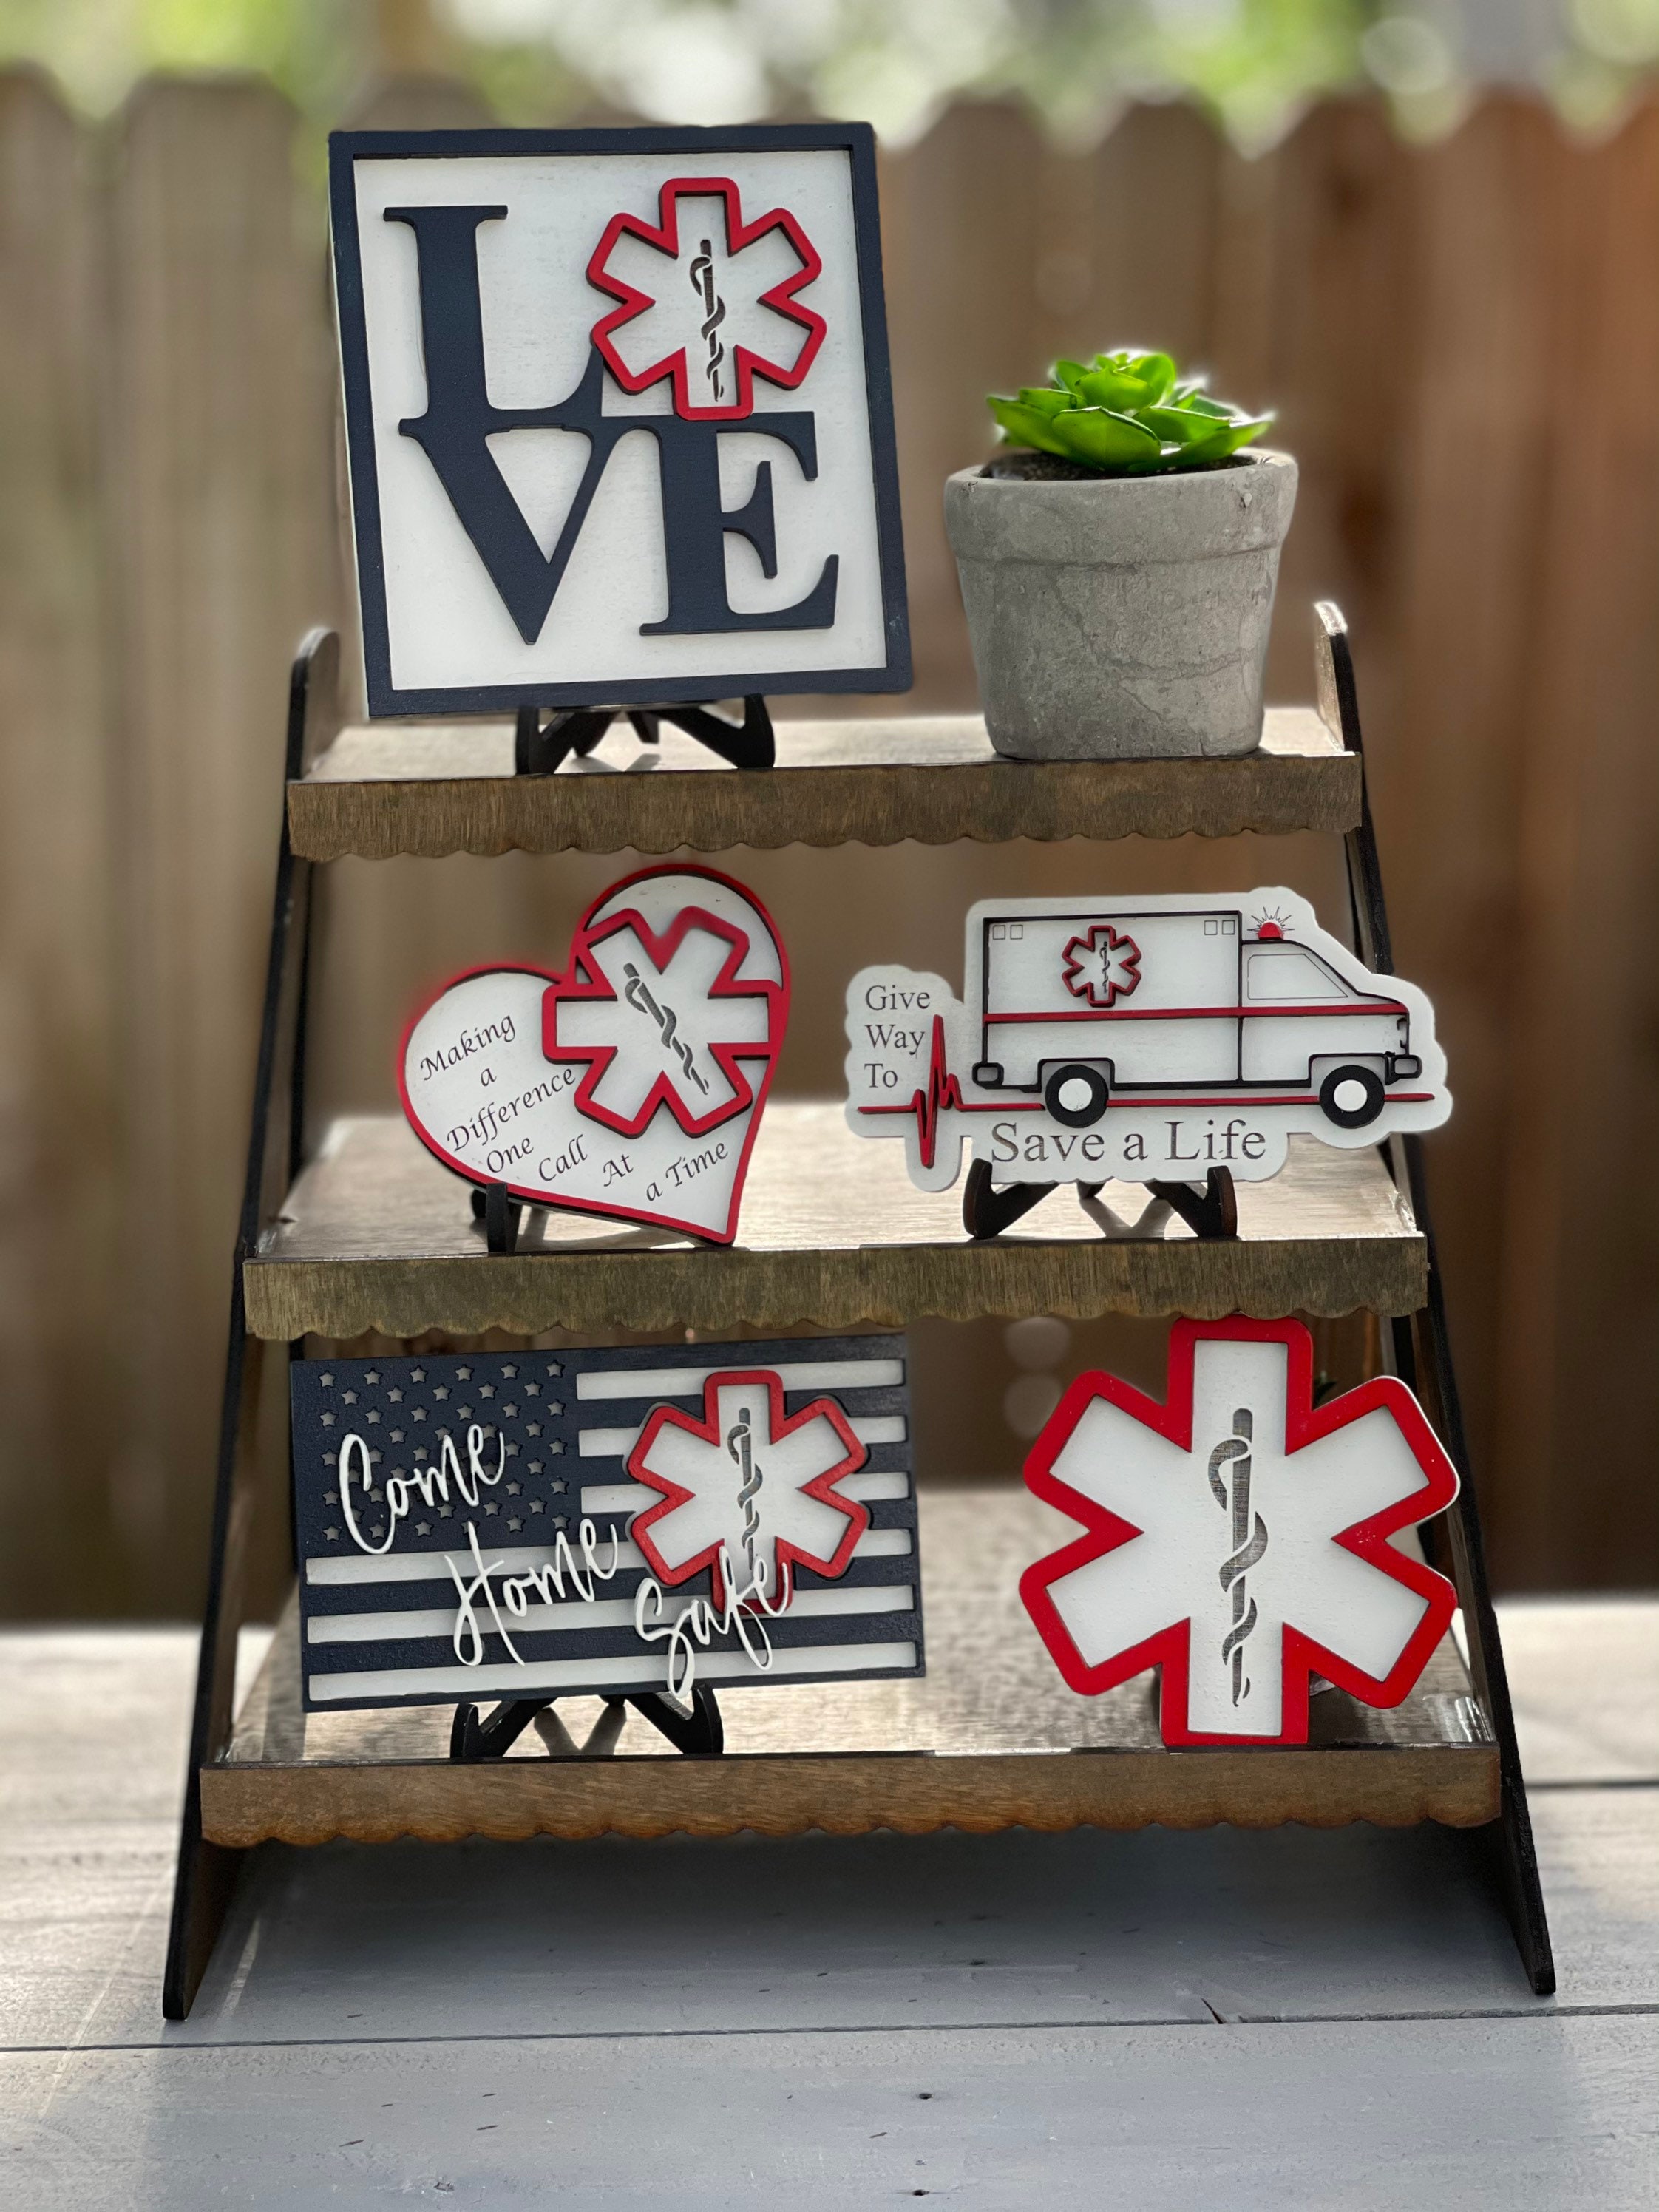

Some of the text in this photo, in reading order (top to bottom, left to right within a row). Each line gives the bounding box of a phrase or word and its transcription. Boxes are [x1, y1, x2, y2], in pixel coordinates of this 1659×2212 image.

[864, 984, 932, 1011] Give
[419, 1014, 516, 1082] Making
[864, 1023, 926, 1056] Way
[479, 1068, 498, 1088] a
[864, 1062, 899, 1089] To
[446, 1067, 577, 1153] Difference
[991, 1117, 1267, 1164] Save a Life
[486, 1134, 730, 1202] One Call At a Time
[339, 1422, 506, 1555] Come
[444, 1516, 619, 1666] Home
[634, 1544, 790, 1700] Safe
